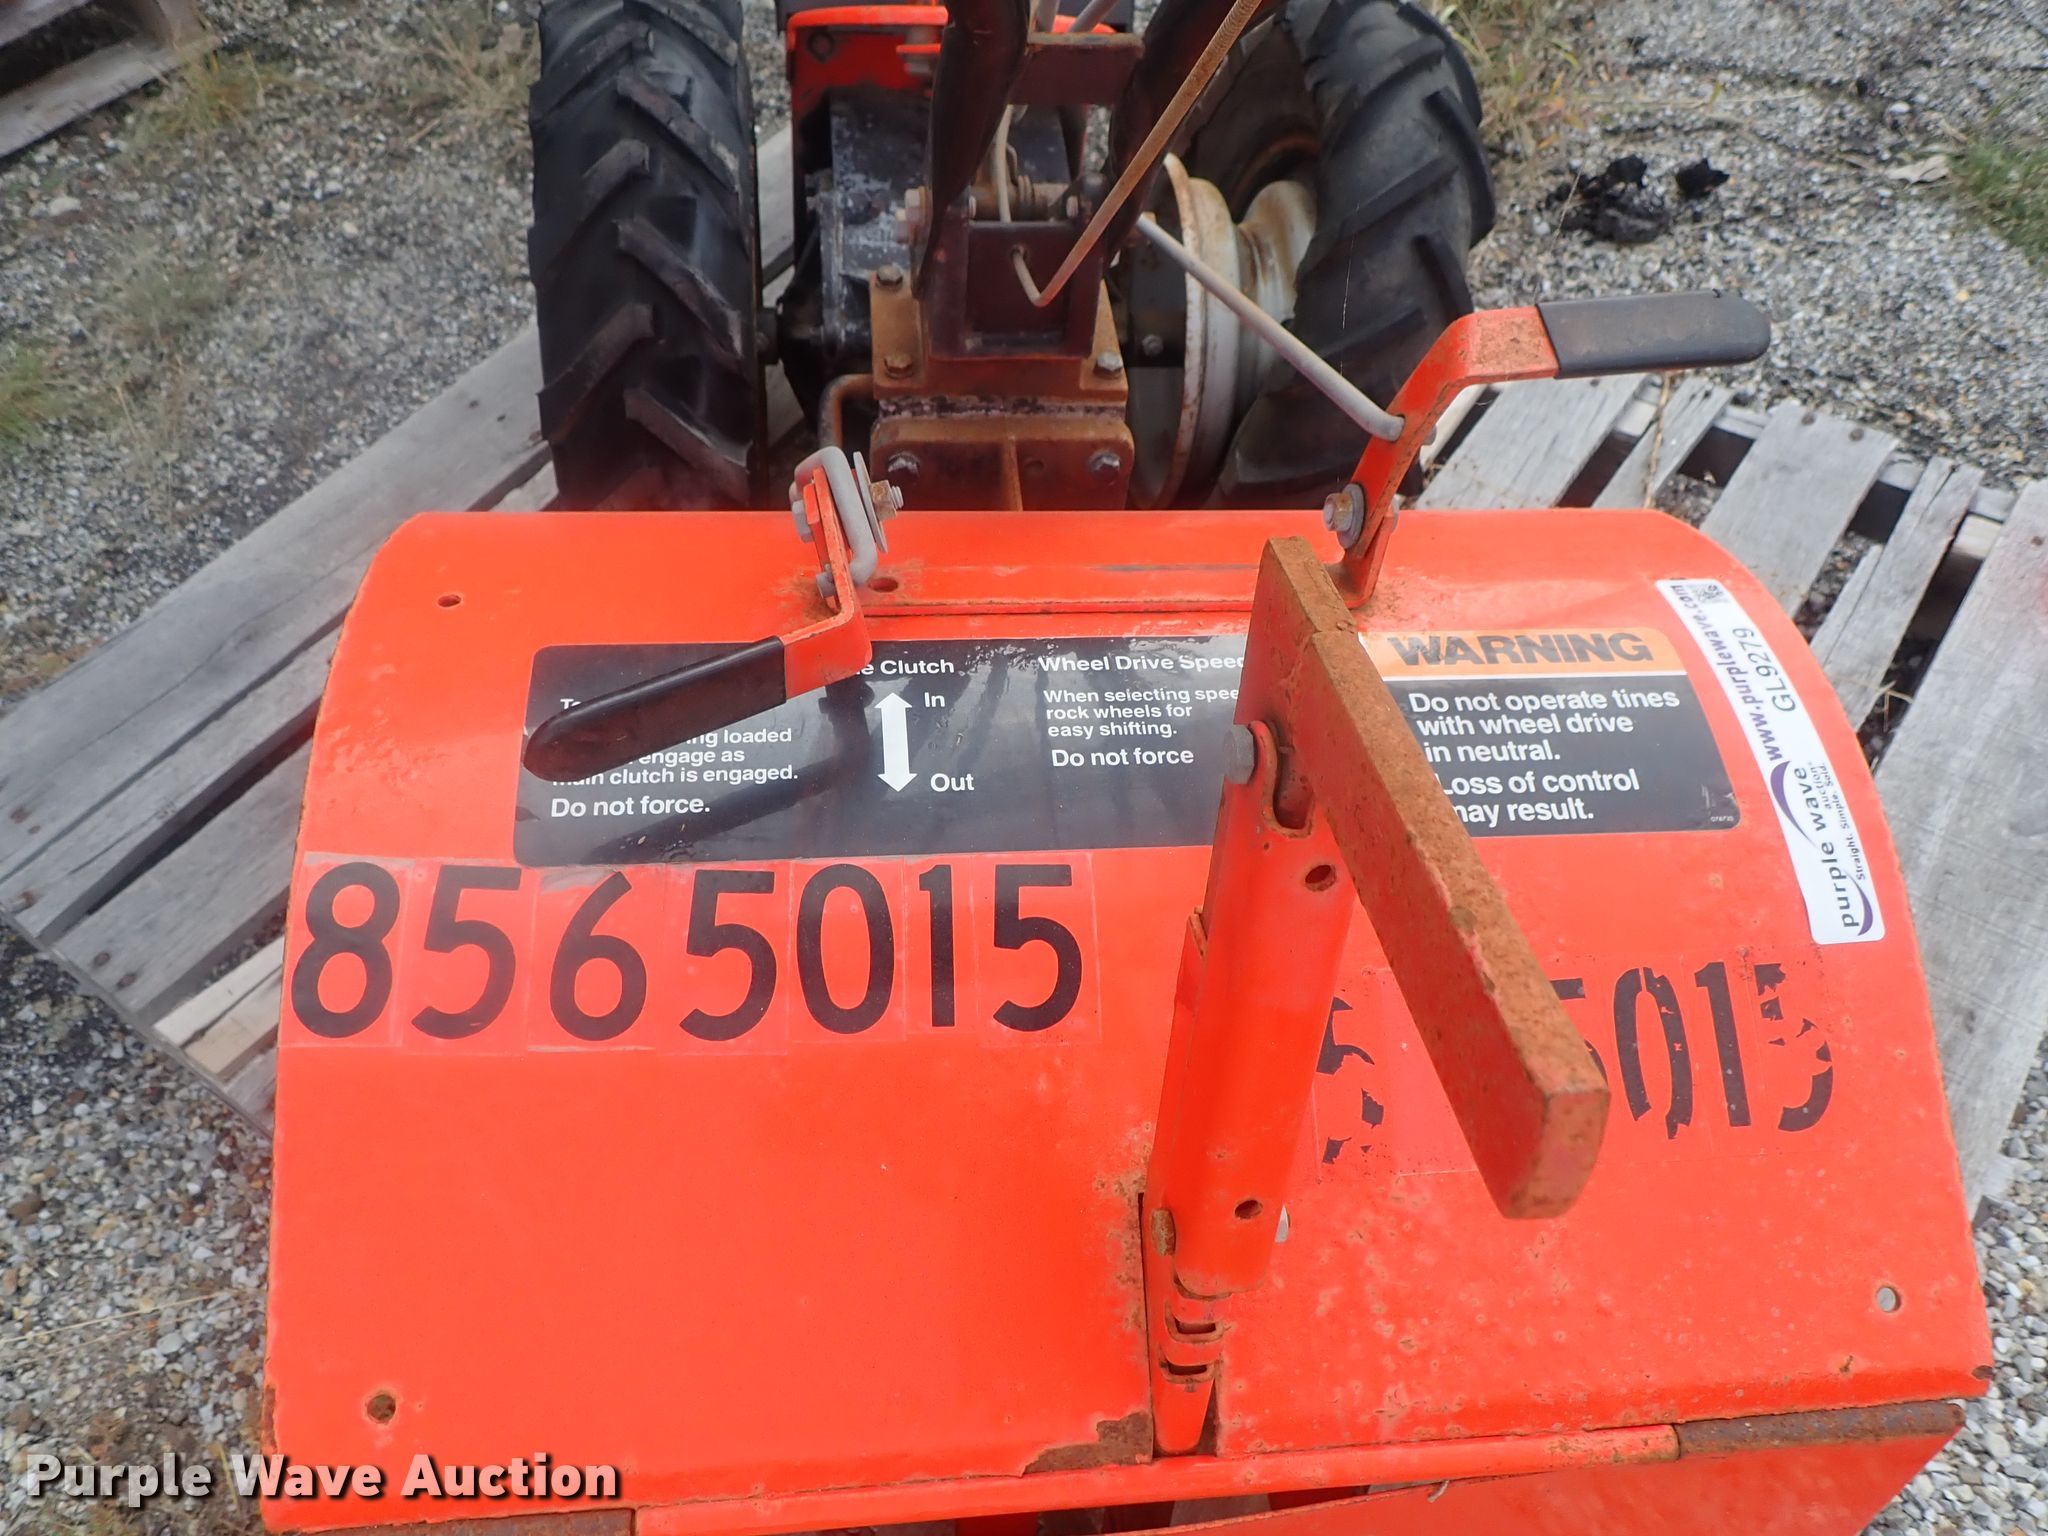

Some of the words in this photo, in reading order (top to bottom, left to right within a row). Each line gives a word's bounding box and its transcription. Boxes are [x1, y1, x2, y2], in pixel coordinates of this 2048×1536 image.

[1387, 633, 1653, 666] WARNING
[880, 659, 955, 675] Clutch
[1037, 655, 1111, 672] Wheel
[1116, 655, 1174, 671] Drive
[1671, 583, 1783, 761] www.purplewave.com
[1732, 627, 1796, 713] GL9279
[924, 692, 946, 708] In
[1043, 689, 1099, 703] When
[1104, 687, 1190, 703] selecting
[1195, 689, 1239, 702] spee
[1409, 692, 1450, 713] Do
[1457, 693, 1501, 712] not
[1504, 691, 1608, 714] operate
[1612, 687, 1680, 709] tines
[1046, 705, 1089, 720] rock
[1094, 705, 1162, 719] wheels
[1166, 704, 1193, 717] for
[1047, 723, 1094, 741] easy
[1099, 721, 1178, 738] shifting.
[1416, 716, 1475, 736] with
[1480, 713, 1560, 735] wheel
[1566, 712, 1634, 733] drive
[724, 728, 792, 744] loaded
[639, 750, 716, 768] engage
[721, 750, 745, 763] as
[1051, 749, 1085, 767] Do
[1090, 748, 1128, 766] not
[1133, 747, 1195, 765] force
[1424, 742, 1451, 763] in
[1457, 739, 1560, 762] neutral.
[610, 767, 675, 785] clutch
[680, 767, 698, 782] is
[702, 765, 798, 784] engaged.
[930, 773, 975, 791] Out
[1508, 770, 1536, 794] of
[1542, 768, 1641, 792] control
[551, 799, 587, 818] Do
[593, 797, 634, 816] not
[640, 795, 711, 816] force.
[1506, 797, 1594, 822] result.
[1795, 767, 1827, 831] wave
[1821, 841, 1860, 928] purple
[291, 861, 1082, 1043] 8565015
